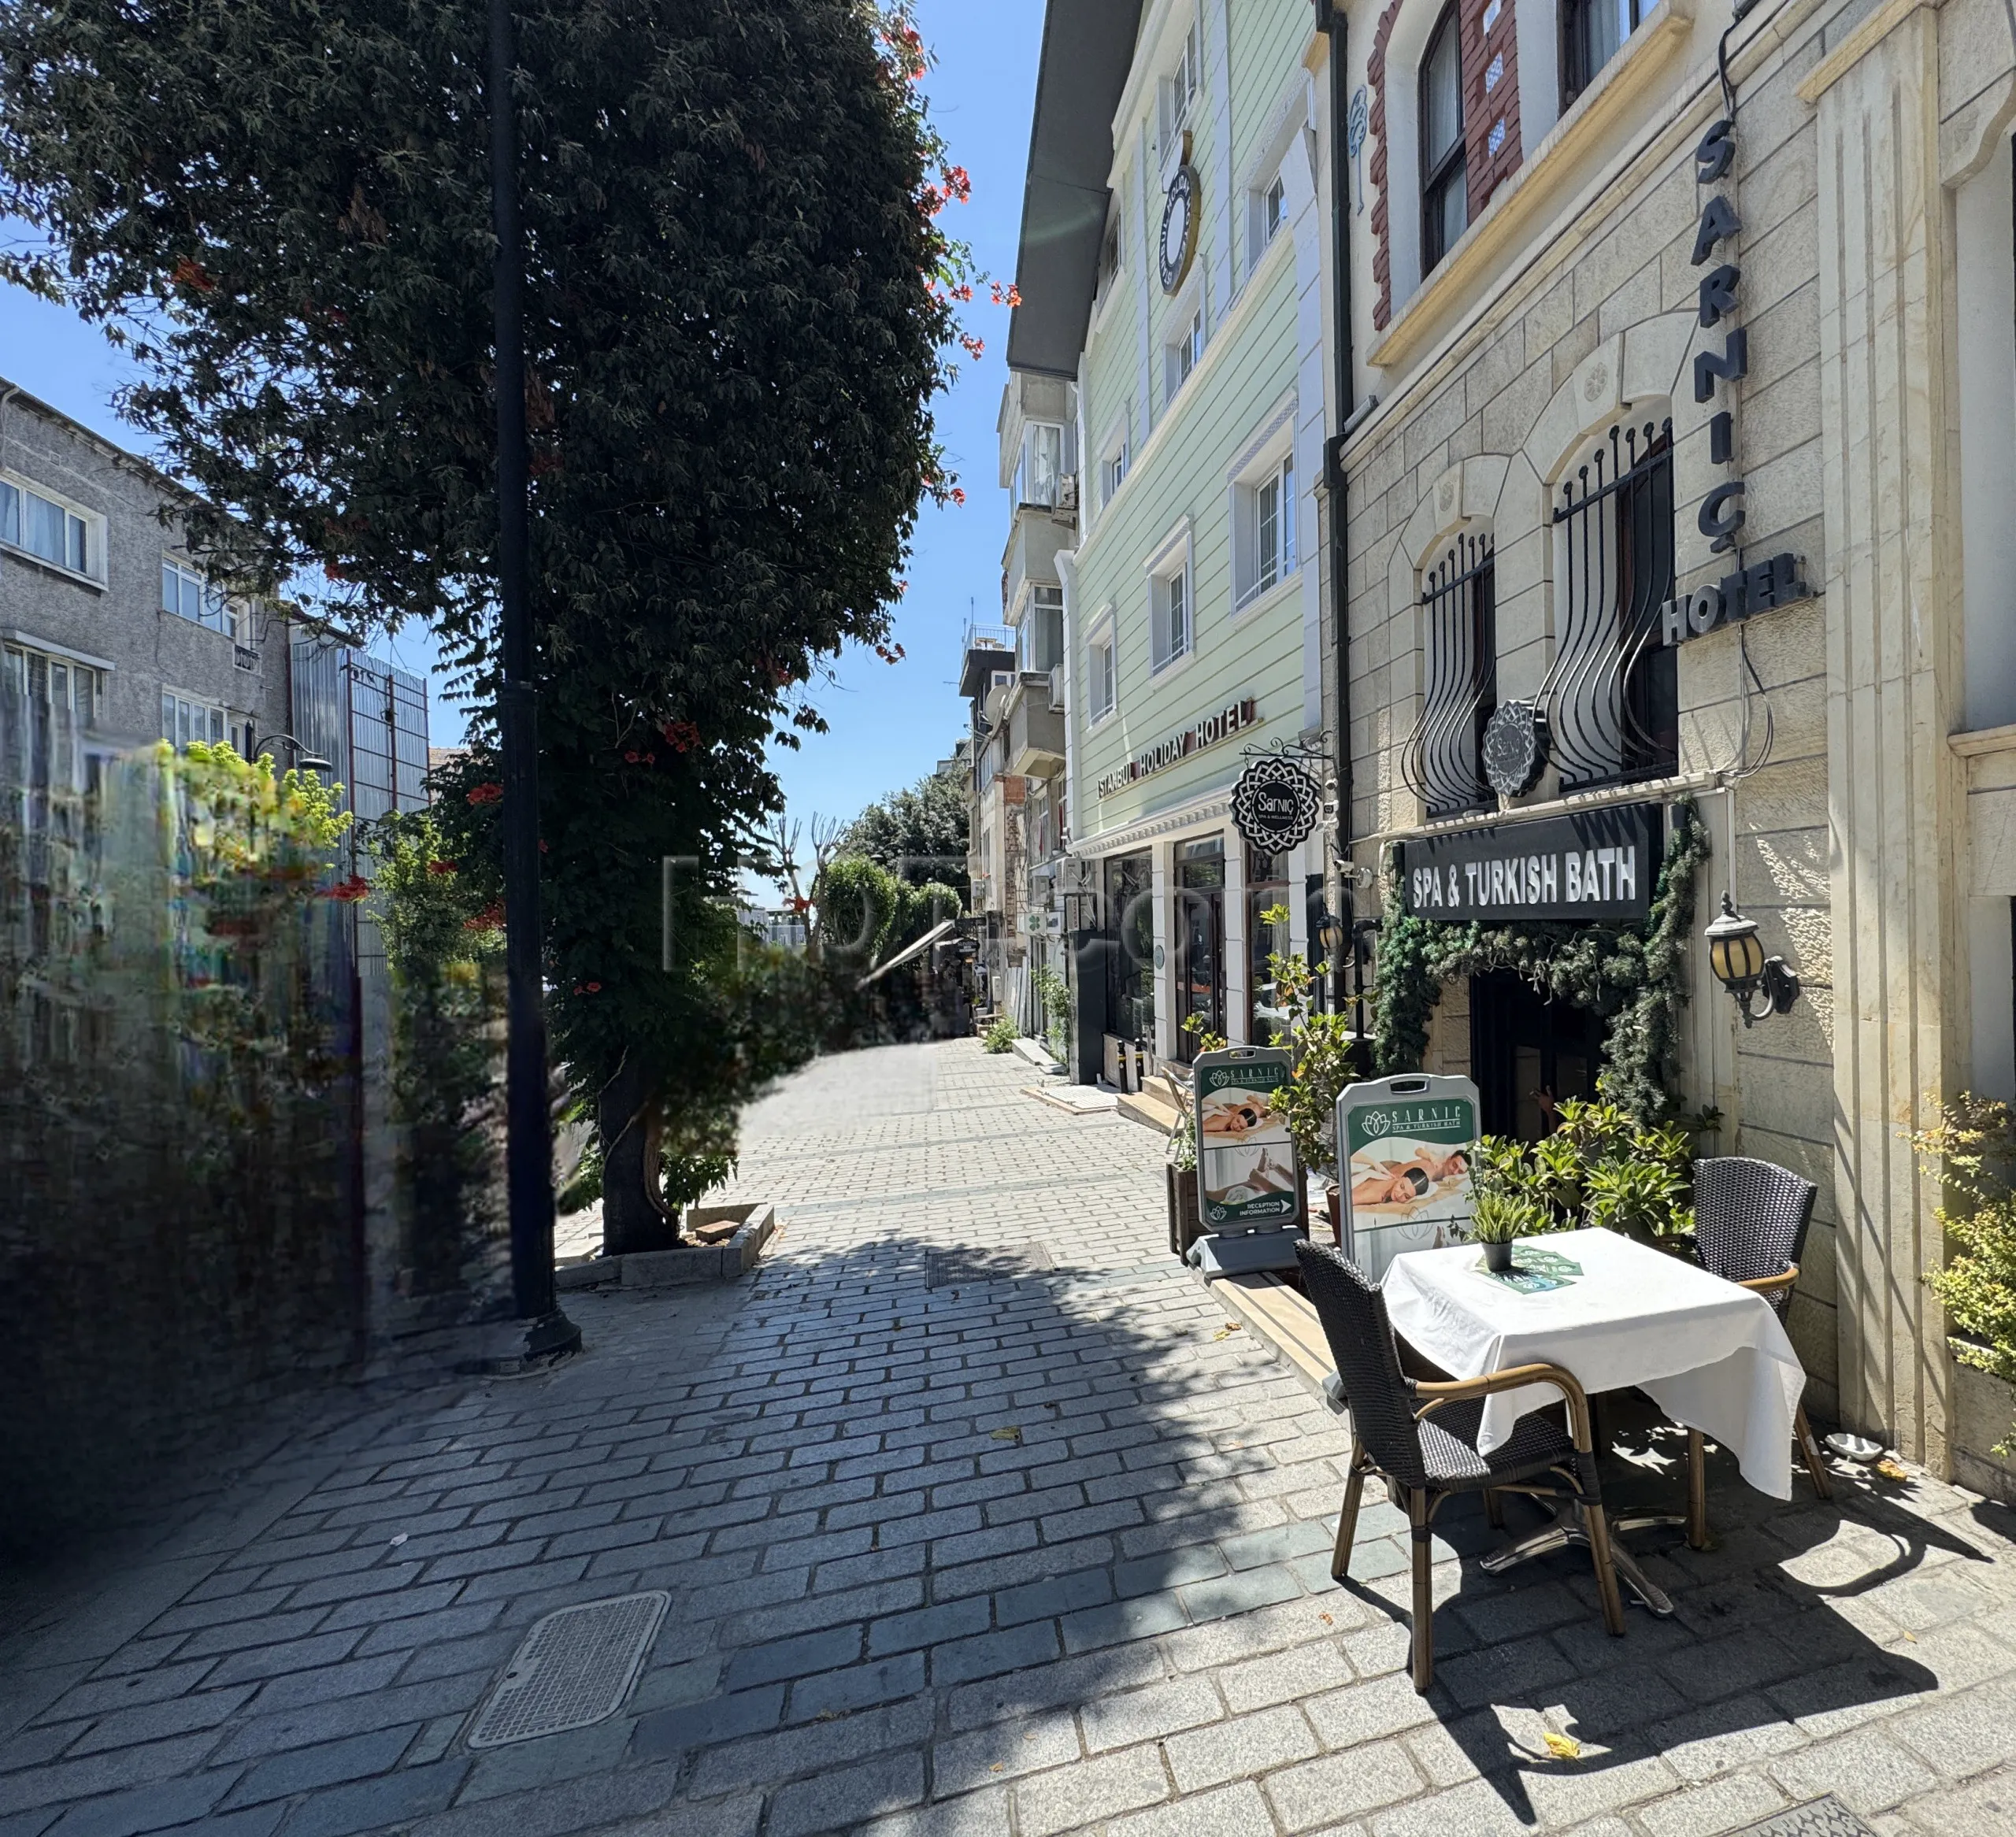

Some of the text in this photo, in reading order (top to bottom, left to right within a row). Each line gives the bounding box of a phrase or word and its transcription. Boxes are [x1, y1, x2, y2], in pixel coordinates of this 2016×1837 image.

[1690, 120, 1748, 554] SARNIÇ
[1662, 552, 1807, 646] HOTEL
[1140, 731, 1186, 776] HOLIDAY
[1195, 700, 1247, 748] HOTEL
[1413, 846, 1636, 908] SPA & TURKISH BATH
[1392, 1106, 1460, 1123] SARNIC
